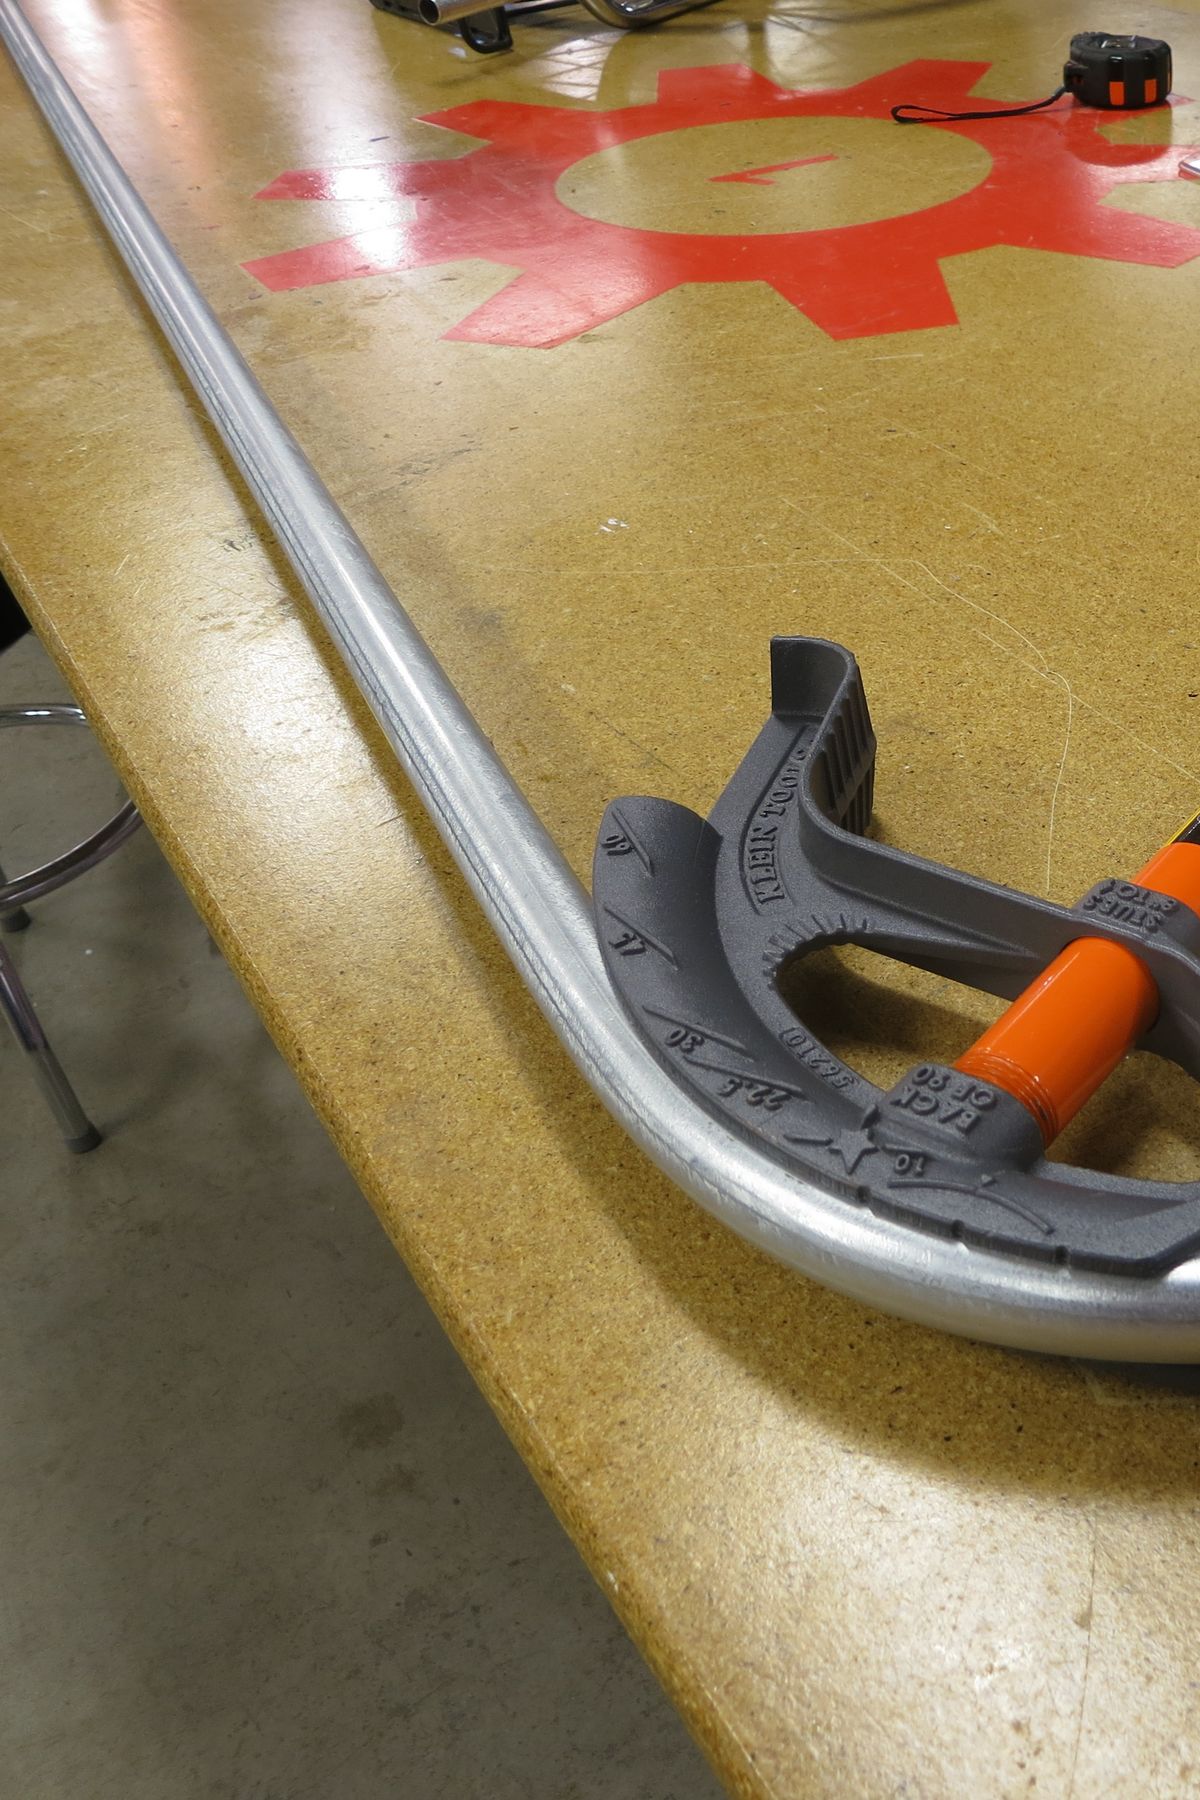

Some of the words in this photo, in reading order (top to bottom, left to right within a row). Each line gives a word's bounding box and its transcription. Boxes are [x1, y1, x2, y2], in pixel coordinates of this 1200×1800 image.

[749, 825, 786, 906] KLEIN
[889, 1083, 981, 1136] BACK
[950, 1084, 998, 1111] OF
[893, 1152, 925, 1178] 10
